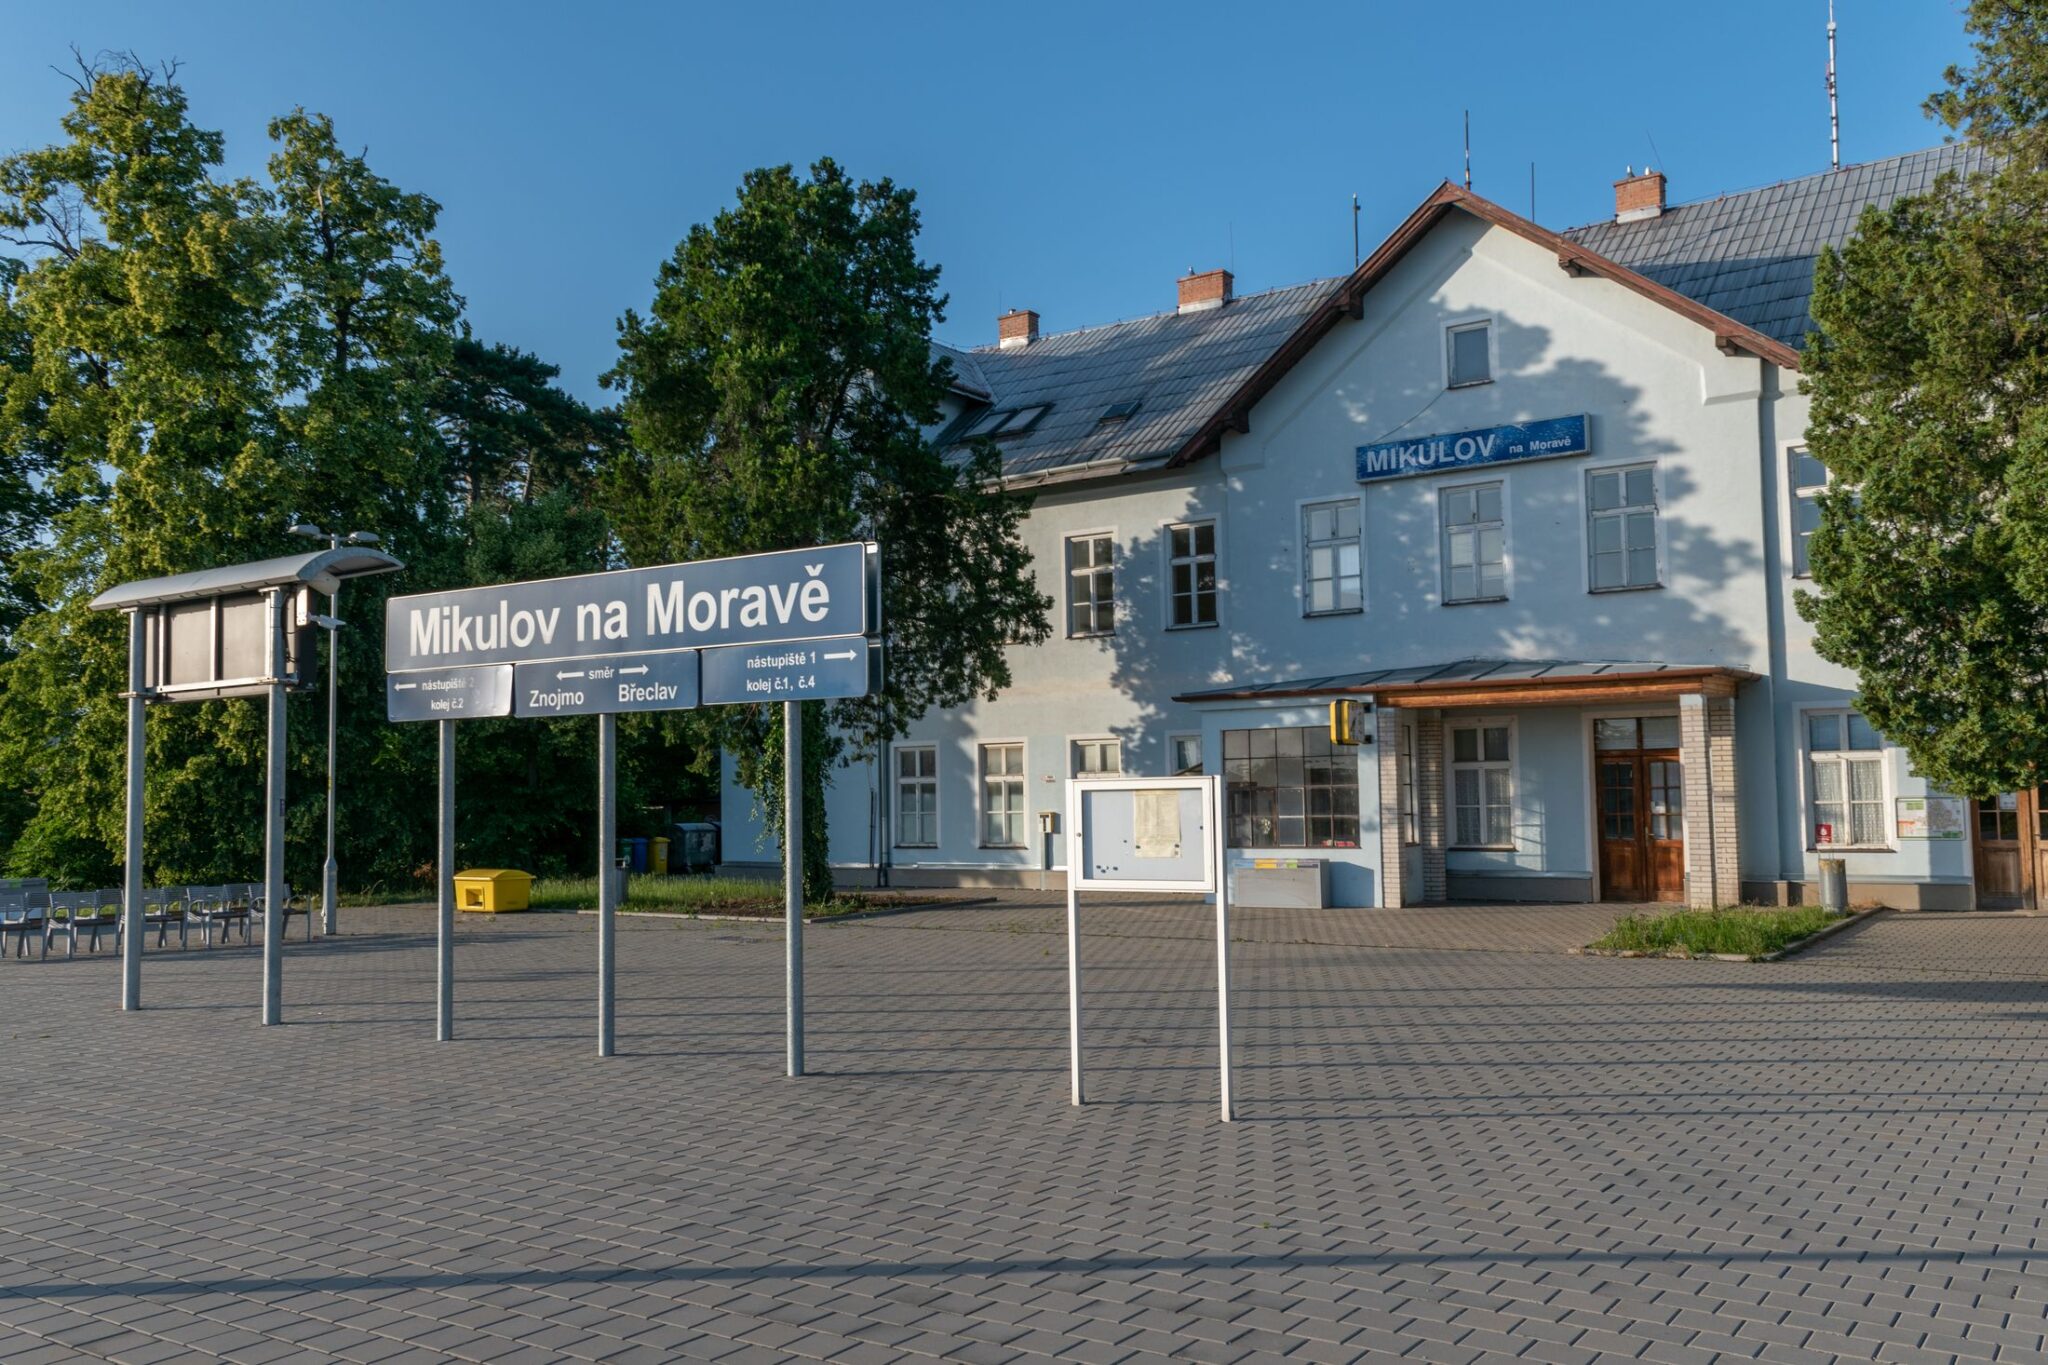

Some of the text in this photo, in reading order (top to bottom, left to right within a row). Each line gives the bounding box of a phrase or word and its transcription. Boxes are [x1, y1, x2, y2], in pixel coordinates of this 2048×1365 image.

[1366, 434, 1496, 473] MIKULOV
[1509, 444, 1524, 454] na
[410, 563, 830, 657] Mikulov na Moravě
[747, 651, 816, 669] nástupiště 1
[588, 666, 615, 680] směr
[618, 682, 678, 702] Břeclav
[746, 675, 815, 693] kolej č.1, č.4
[431, 697, 463, 711] kolej č.2
[529, 688, 584, 710] Znojmo
